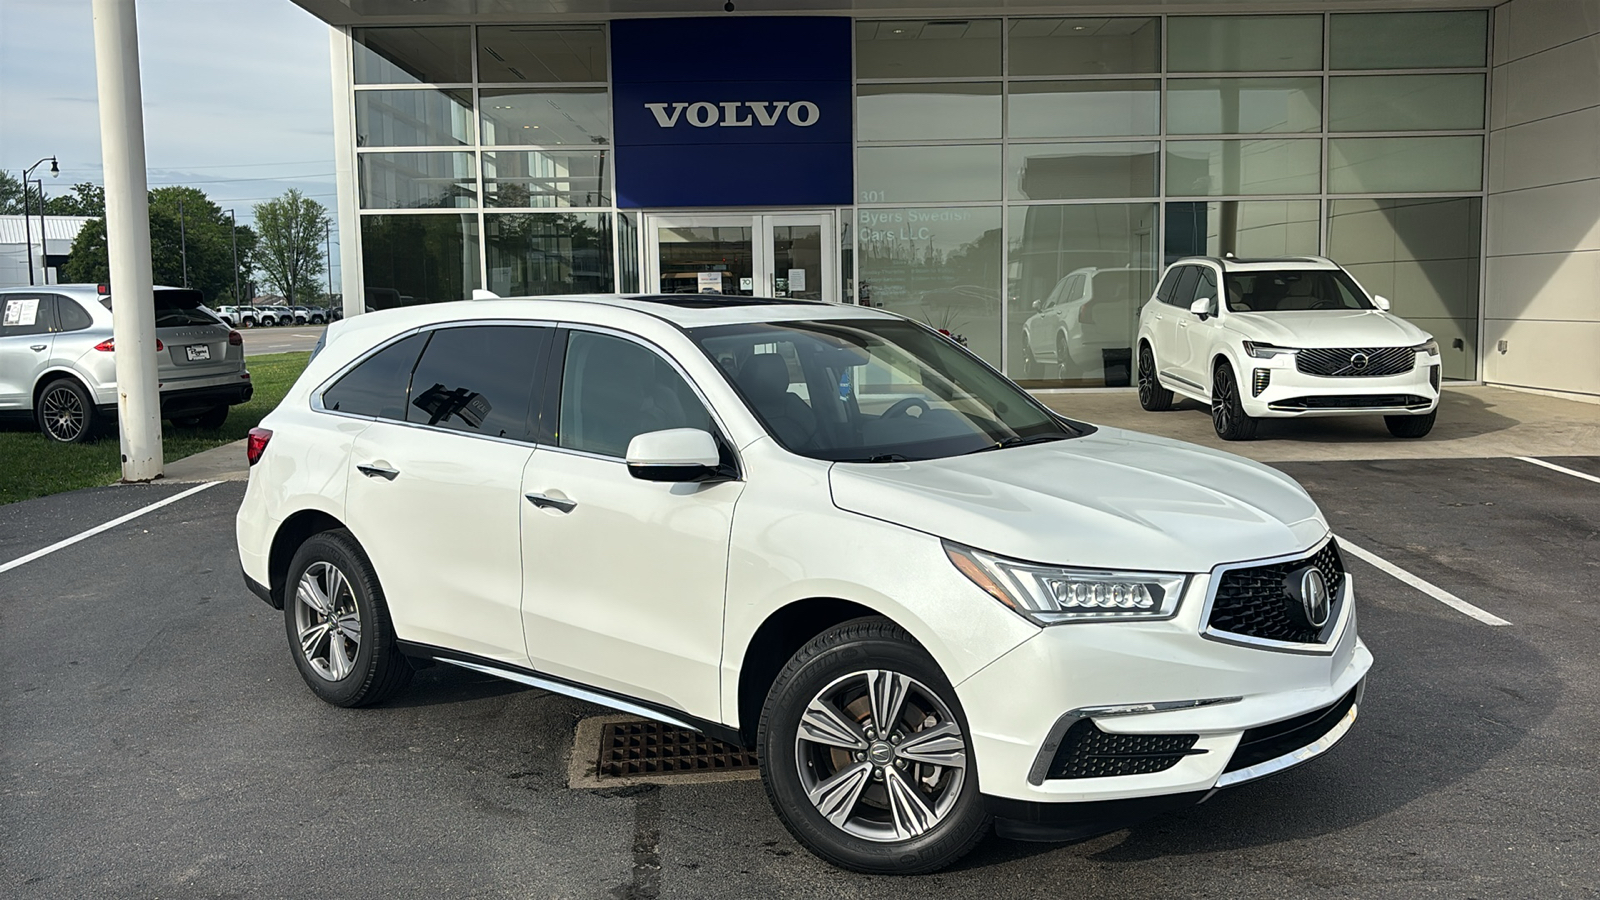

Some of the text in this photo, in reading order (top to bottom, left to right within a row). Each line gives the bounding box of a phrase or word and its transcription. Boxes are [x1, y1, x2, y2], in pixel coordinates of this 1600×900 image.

[644, 100, 820, 128] VOLVO
[860, 190, 885, 203] 301
[860, 209, 971, 227] Byers Swedish
[860, 227, 930, 241] Cars LLC
